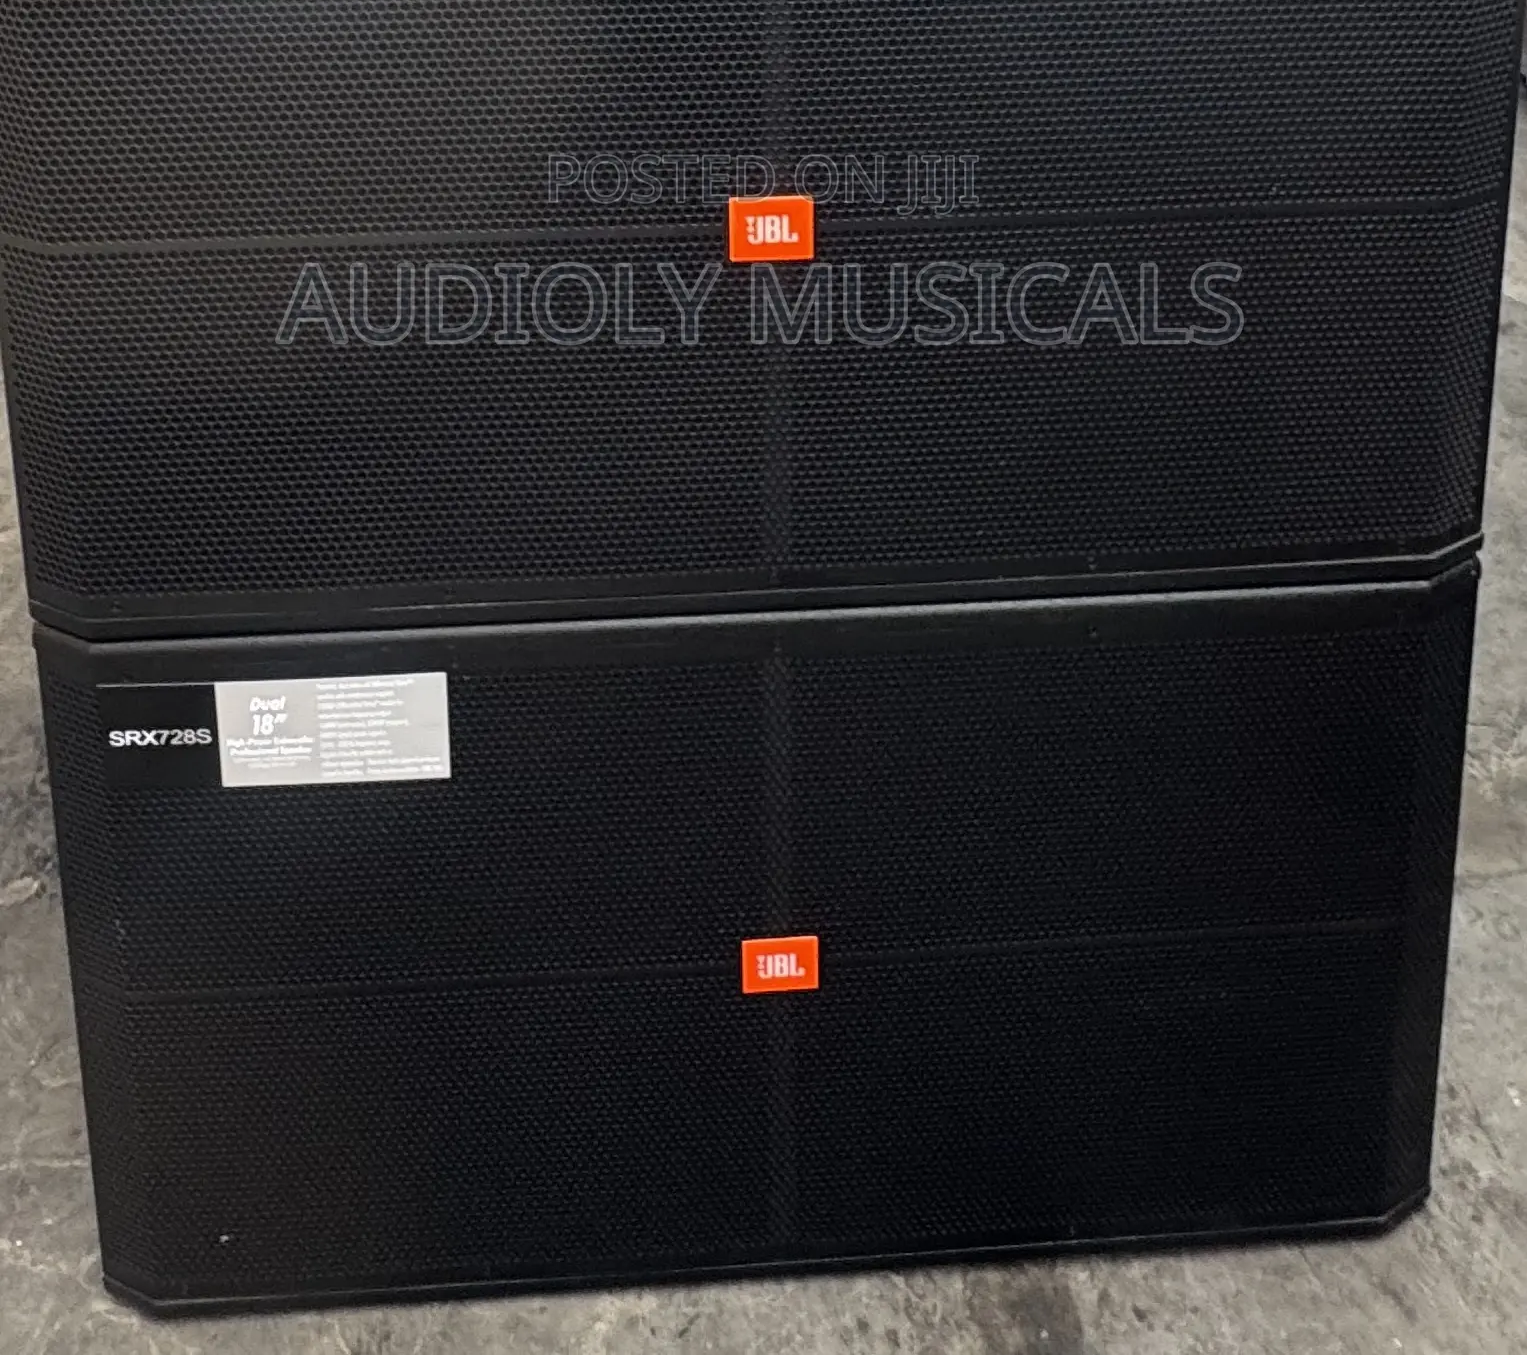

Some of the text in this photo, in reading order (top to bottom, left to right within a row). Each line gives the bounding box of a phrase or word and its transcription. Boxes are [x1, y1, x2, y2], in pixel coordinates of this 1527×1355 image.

[744, 214, 800, 245] JBL
[249, 695, 287, 712] Dual
[108, 728, 213, 748] SRX728S
[756, 952, 806, 979] JBL
